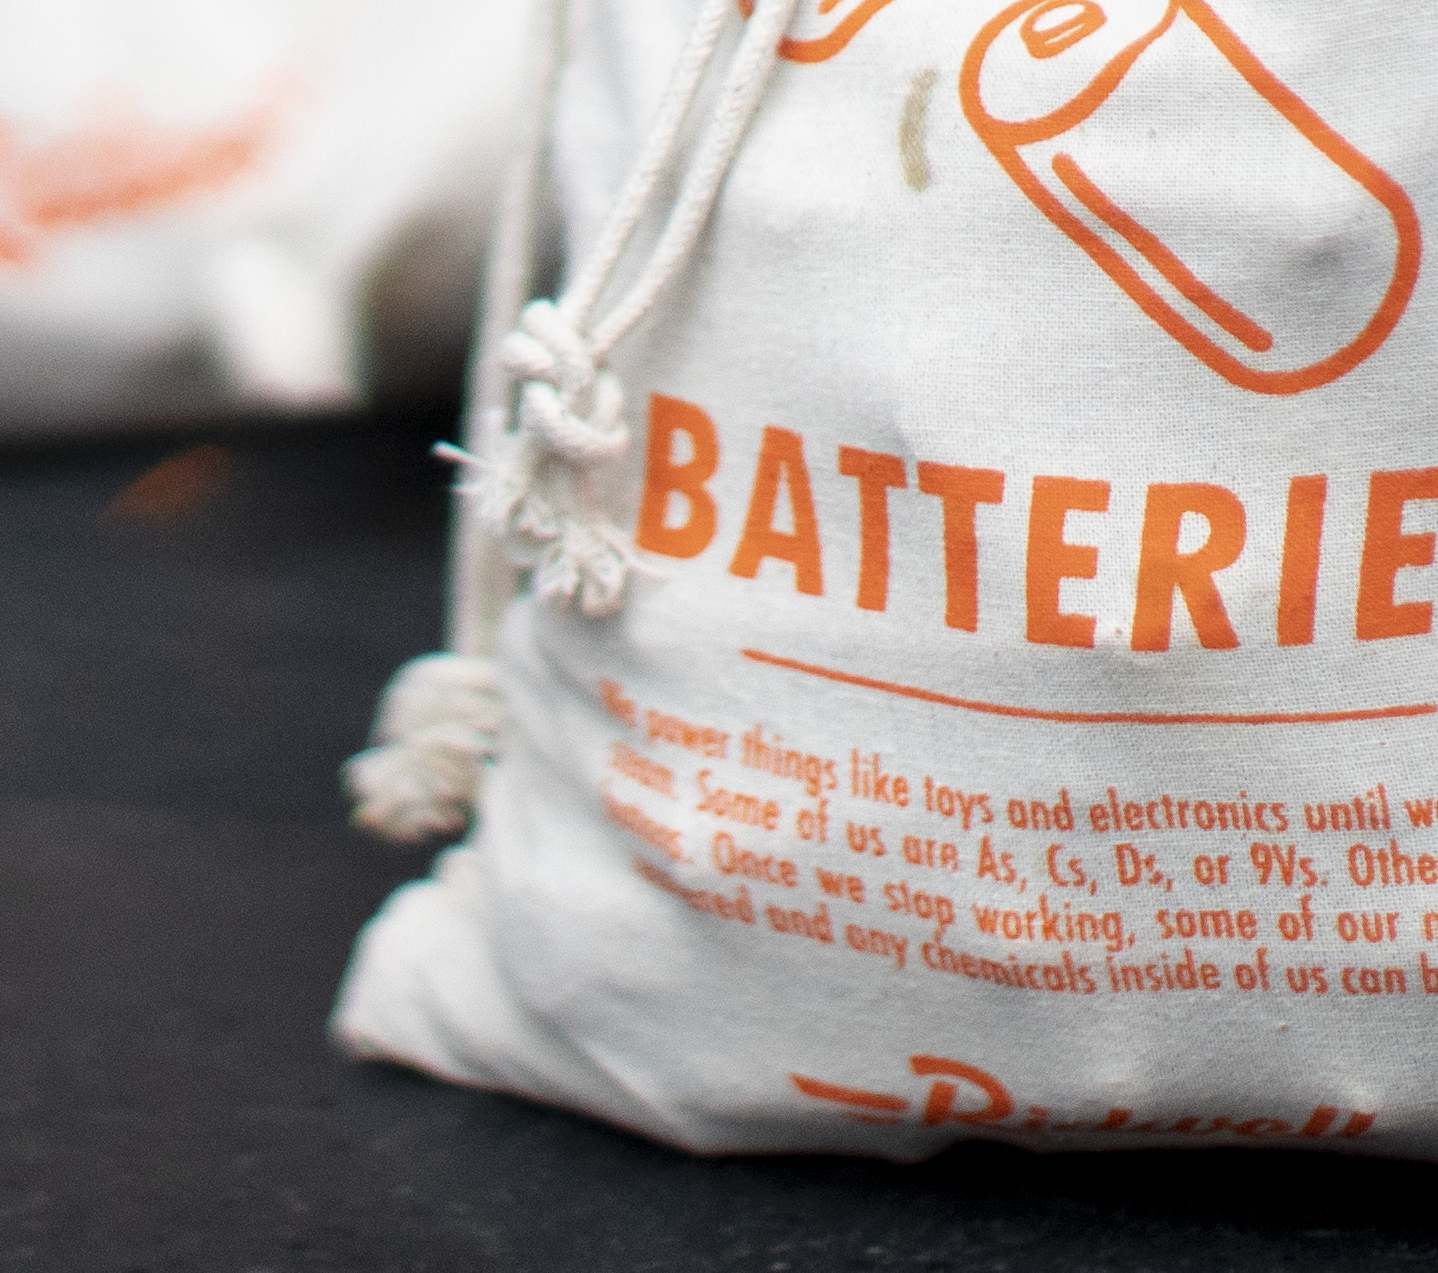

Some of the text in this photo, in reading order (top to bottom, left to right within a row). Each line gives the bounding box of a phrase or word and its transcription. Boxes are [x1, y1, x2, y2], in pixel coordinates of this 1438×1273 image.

[695, 768, 781, 831] Some
[795, 796, 830, 845] of
[845, 820, 886, 857] us
[902, 835, 961, 873] are
[976, 834, 1027, 894] As,
[1046, 843, 1098, 897] Cs,
[1115, 843, 1174, 893] Ds,
[1193, 855, 1229, 886] or
[1249, 841, 1327, 888] 9Vs.
[742, 722, 839, 797] things
[850, 748, 910, 808] like
[924, 776, 994, 832] toys
[1006, 787, 1075, 832] and
[1089, 786, 1289, 833] electronics
[1303, 782, 1391, 832] until
[711, 830, 799, 889] Once
[815, 866, 867, 905] we
[883, 880, 955, 945] stop
[971, 893, 1136, 953] working,
[1155, 908, 1258, 941] some
[1278, 893, 1314, 942] of
[1336, 910, 1400, 943] our
[765, 900, 835, 945] and
[843, 922, 910, 971] any
[921, 940, 1097, 995] chemicals
[1106, 947, 1222, 993] inside
[1233, 946, 1270, 992] of
[1285, 965, 1329, 996] us
[1340, 965, 1407, 996] can
